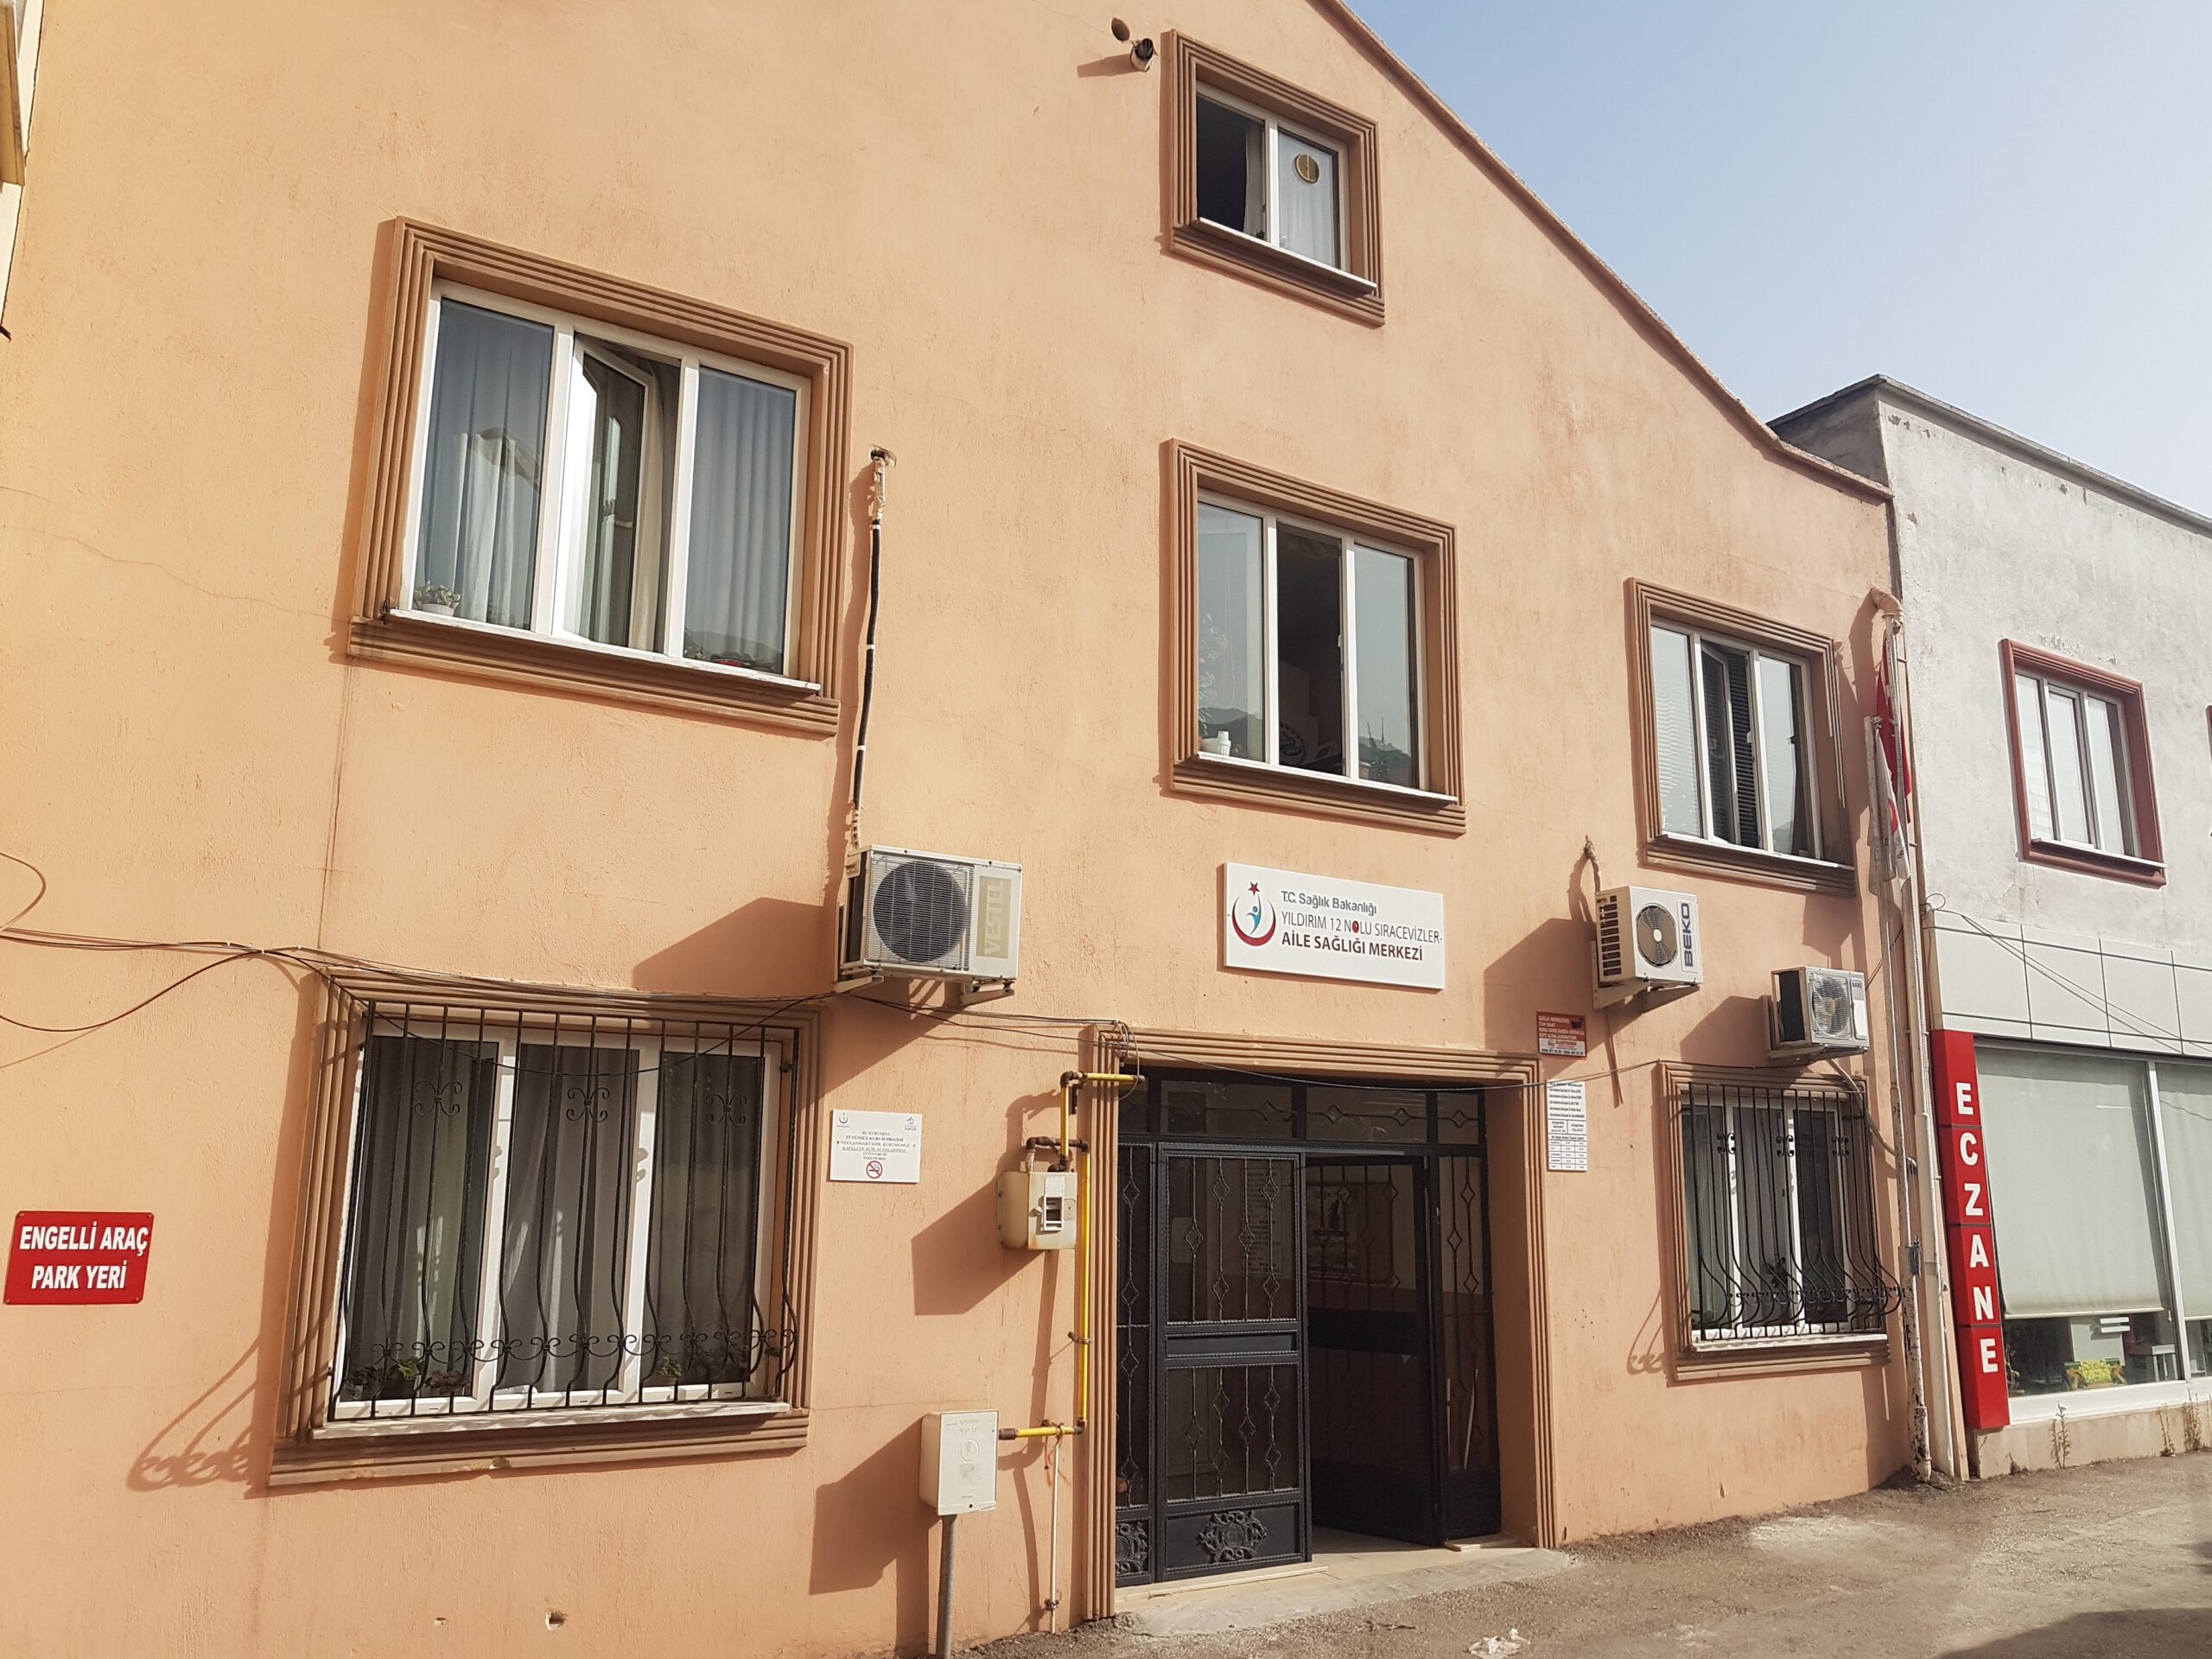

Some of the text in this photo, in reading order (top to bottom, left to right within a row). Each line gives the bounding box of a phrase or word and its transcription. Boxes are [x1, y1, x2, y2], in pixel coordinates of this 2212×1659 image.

[1281, 891, 1377, 917] T.C. Sağlık Bakanlığı
[1281, 911, 1327, 930] YILDIRIM
[1330, 918, 1342, 931] 12
[1375, 923, 1440, 944] SIRACEVİZLER
[1681, 902, 1694, 967] BEKO
[1281, 930, 1423, 961] AİLE SAĞLIĞI MERKEZİ
[19, 1221, 149, 1256] ENGELLİ ARAÇ
[1956, 1082, 1999, 1373] ECZANE
[31, 1260, 127, 1289] PARK YERİ
